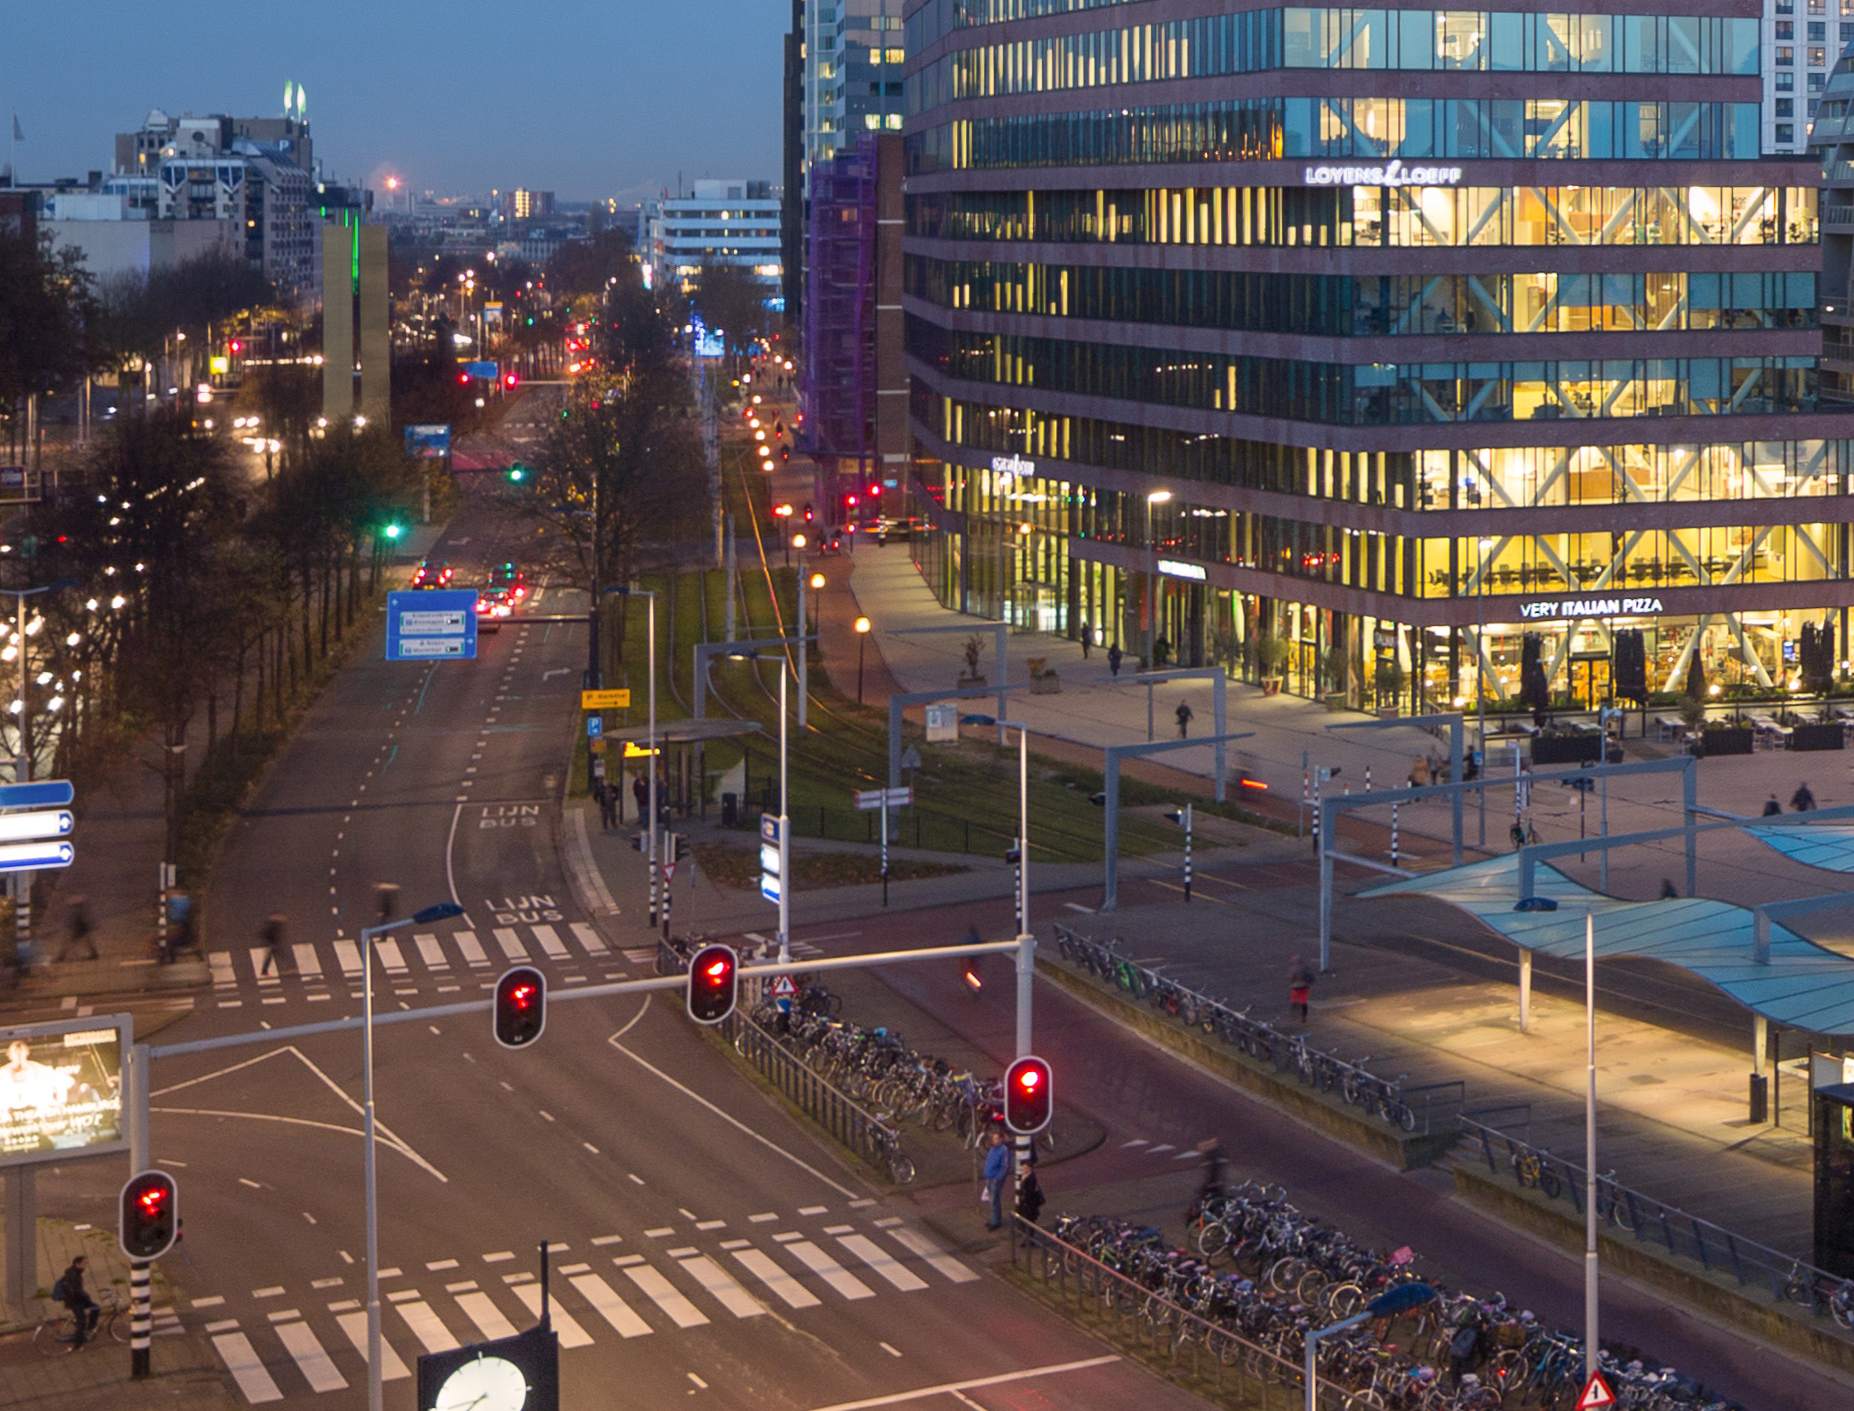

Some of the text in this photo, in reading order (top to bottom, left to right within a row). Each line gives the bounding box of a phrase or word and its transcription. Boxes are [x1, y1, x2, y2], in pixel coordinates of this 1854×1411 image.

[1305, 166, 1383, 185] LOYENS
[1401, 167, 1462, 185] LOEFF
[1520, 597, 1663, 619] VERY ITALIAN PIZZA
[485, 894, 556, 912] LIJN
[495, 909, 564, 925] BUS
